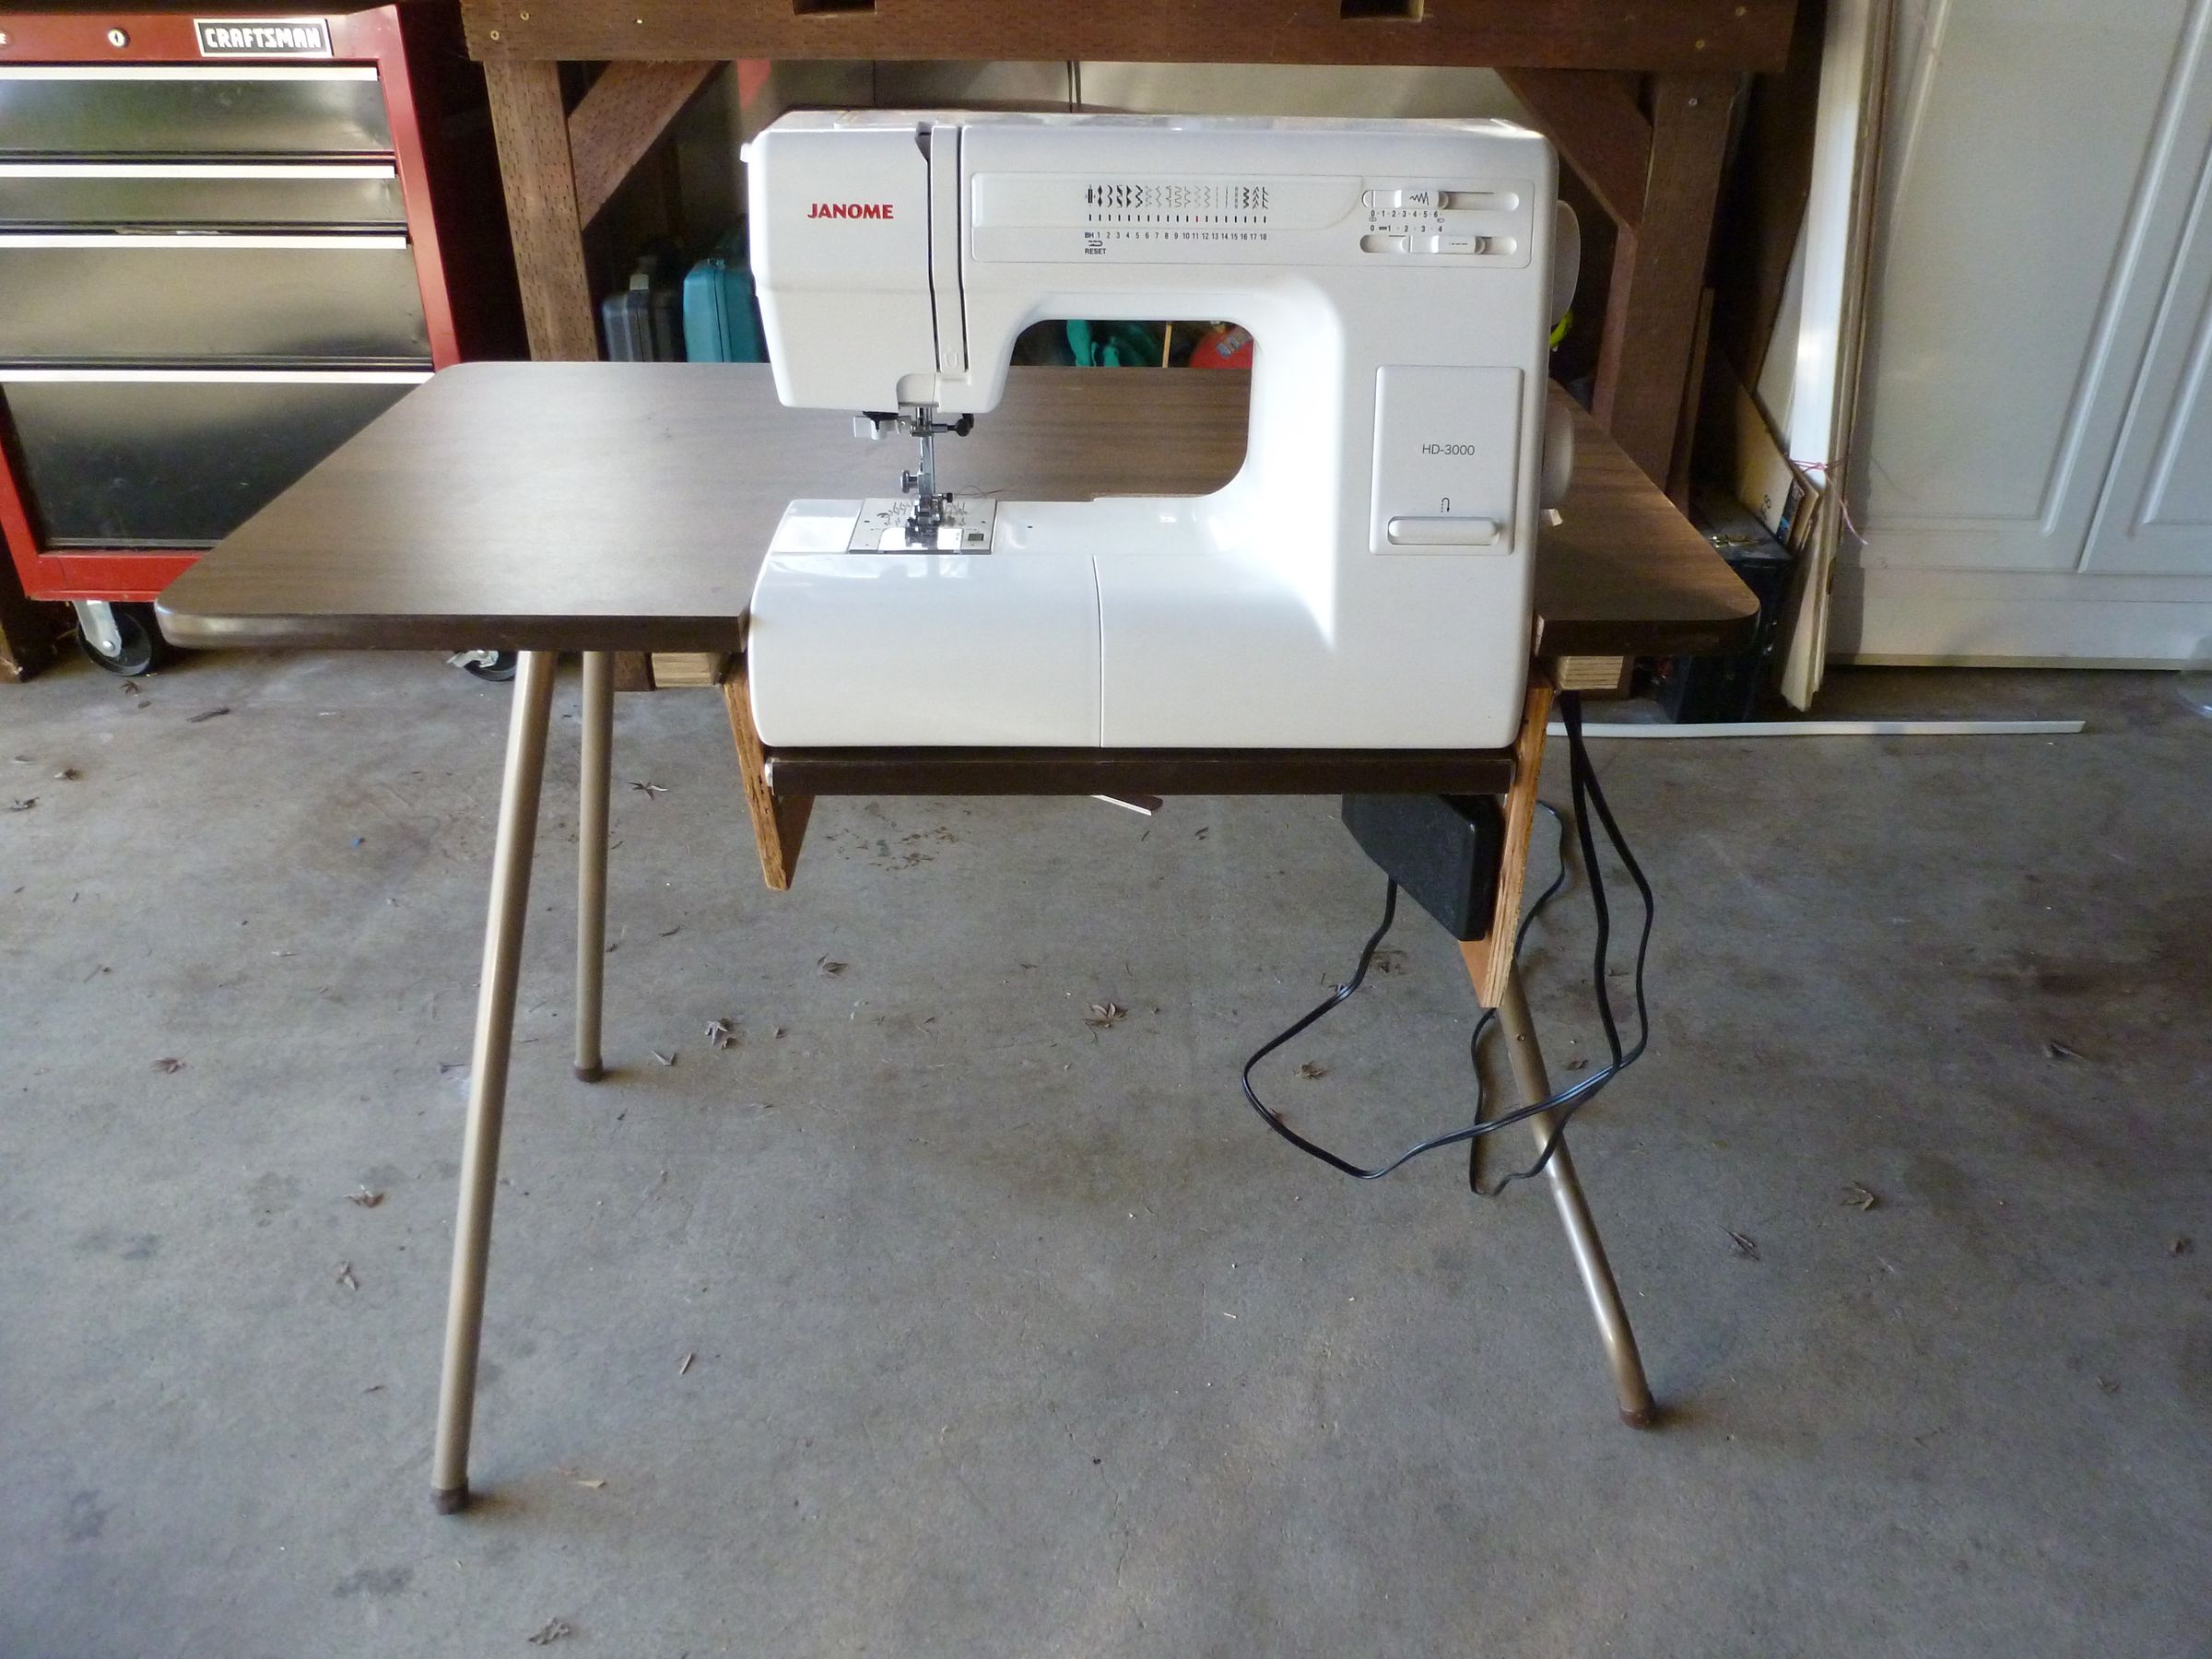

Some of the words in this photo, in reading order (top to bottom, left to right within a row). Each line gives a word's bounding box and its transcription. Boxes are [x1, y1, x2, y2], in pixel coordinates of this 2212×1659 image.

[205, 28, 322, 49] CRAFTSMAN
[807, 203, 894, 219] JANOME
[1182, 232, 1191, 241] 10
[1192, 232, 1200, 241] 11
[1202, 232, 1210, 241] 12
[1211, 232, 1220, 241] 13
[1221, 232, 1230, 241] 14
[1230, 232, 1239, 241] 15
[1240, 232, 1249, 241] 16
[1250, 232, 1258, 241] 17
[1260, 232, 1268, 241] 18
[1422, 443, 1476, 456] HD-3000
